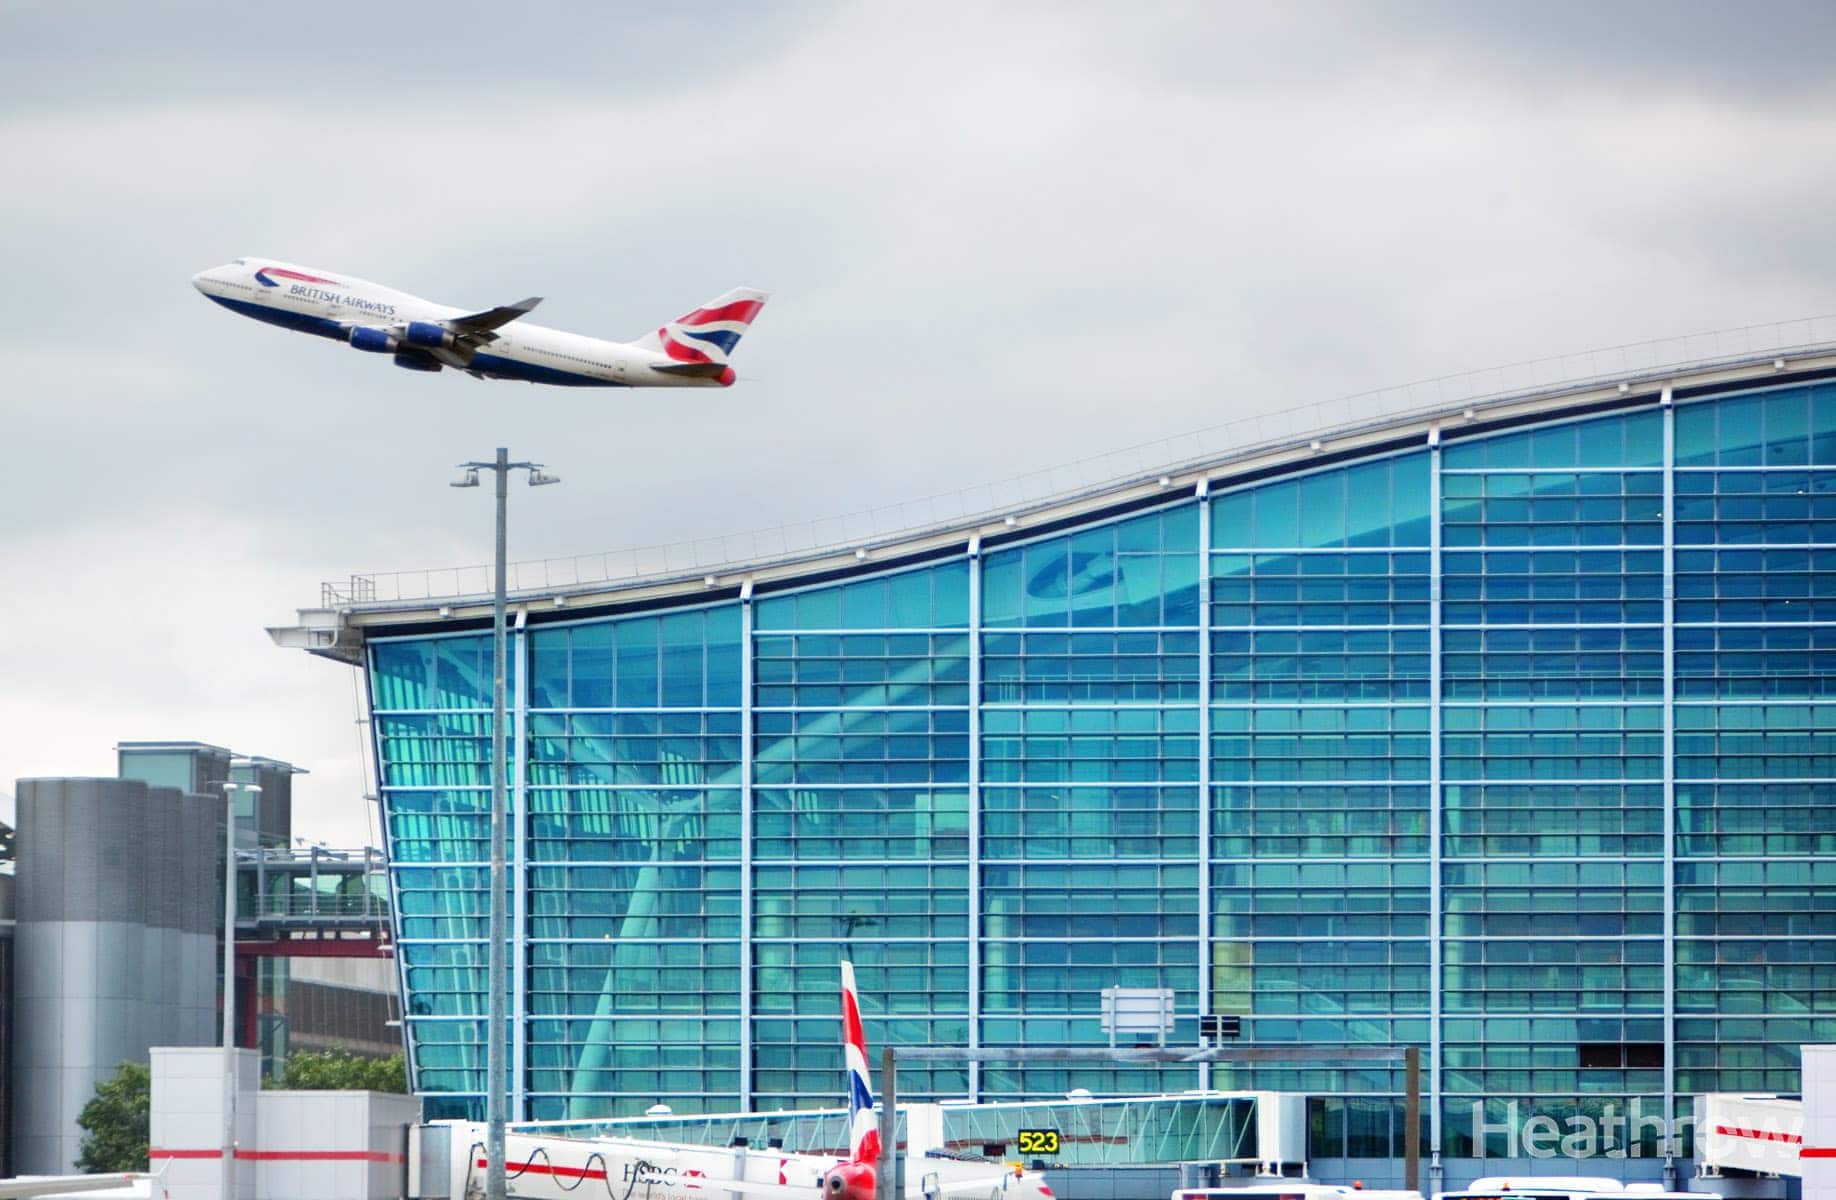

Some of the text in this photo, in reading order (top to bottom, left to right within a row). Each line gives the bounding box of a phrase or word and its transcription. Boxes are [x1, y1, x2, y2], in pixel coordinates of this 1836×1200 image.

[290, 284, 396, 316] BRITISH AIRWAYS
[1019, 1131, 1059, 1153] 523
